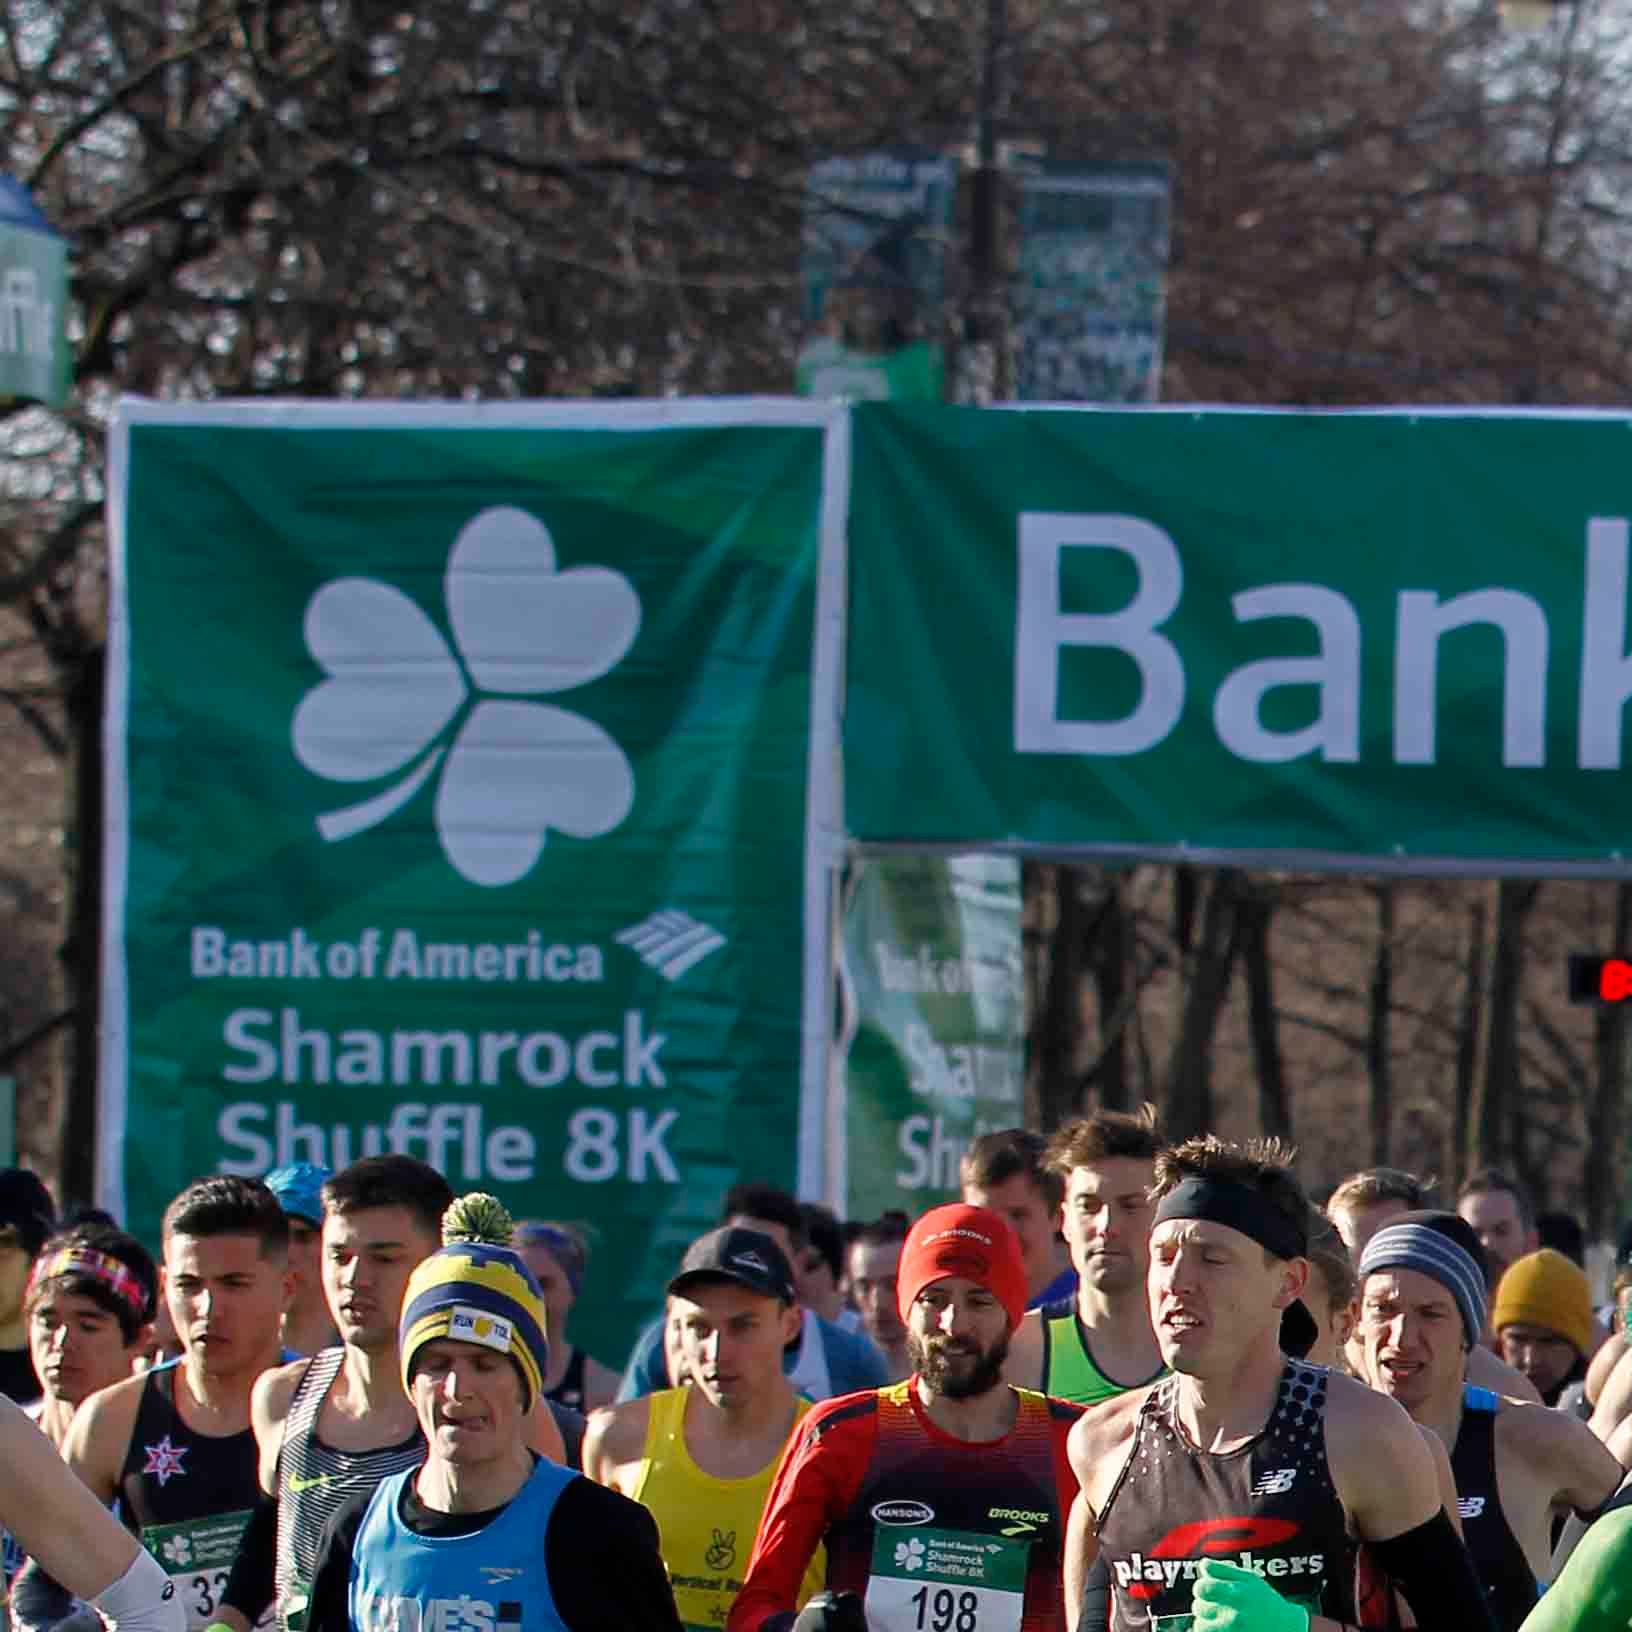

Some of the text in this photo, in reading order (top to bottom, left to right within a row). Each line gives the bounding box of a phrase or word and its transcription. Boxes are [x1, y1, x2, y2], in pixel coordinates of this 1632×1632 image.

[191, 926, 605, 982] Bank of America
[222, 1008, 667, 1088] Shamrock
[216, 1101, 681, 1184] Shuffle 8K
[987, 1507, 1050, 1524] BROOKS
[926, 1562, 968, 1577] Shuffle
[927, 1550, 984, 1567] Shamrock
[1112, 1551, 1325, 1589] playmkers
